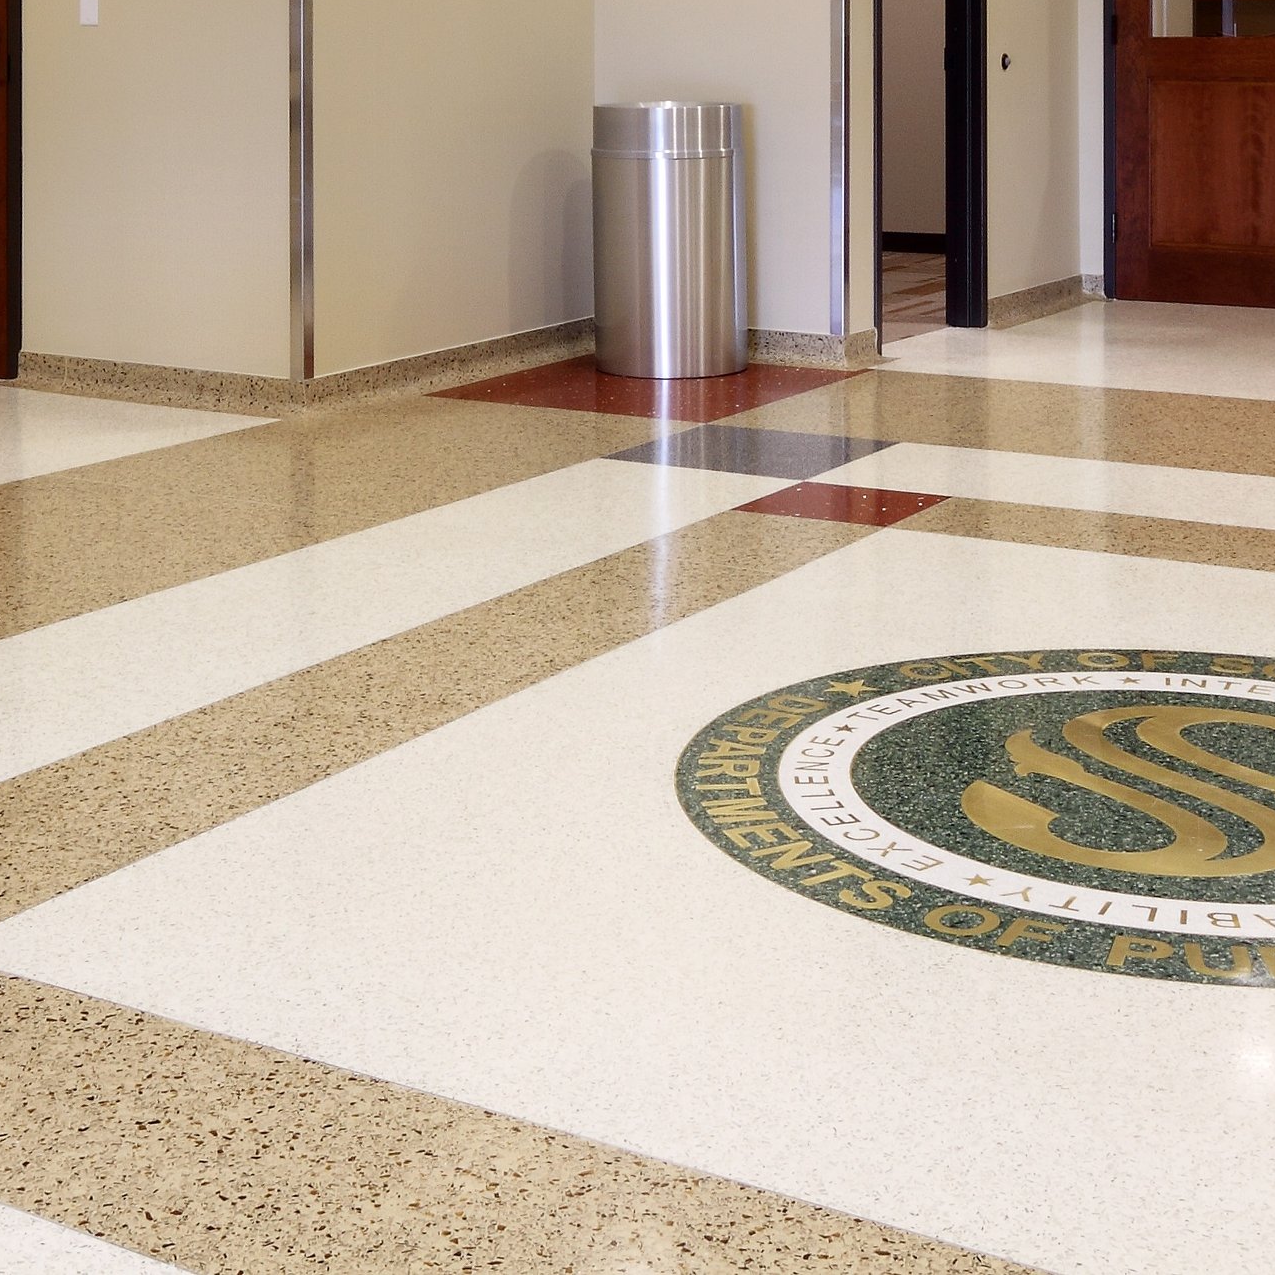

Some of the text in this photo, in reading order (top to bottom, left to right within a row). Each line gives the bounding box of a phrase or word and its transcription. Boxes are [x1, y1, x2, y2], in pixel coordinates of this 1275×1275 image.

[846, 675, 1101, 722] TEAMWORK
[898, 651, 1046, 681] CITY
[1076, 651, 1179, 673] OF
[695, 694, 912, 910] DEPARTMENTS
[924, 904, 1067, 947] OF
[794, 735, 944, 872] EXCELLENCE
